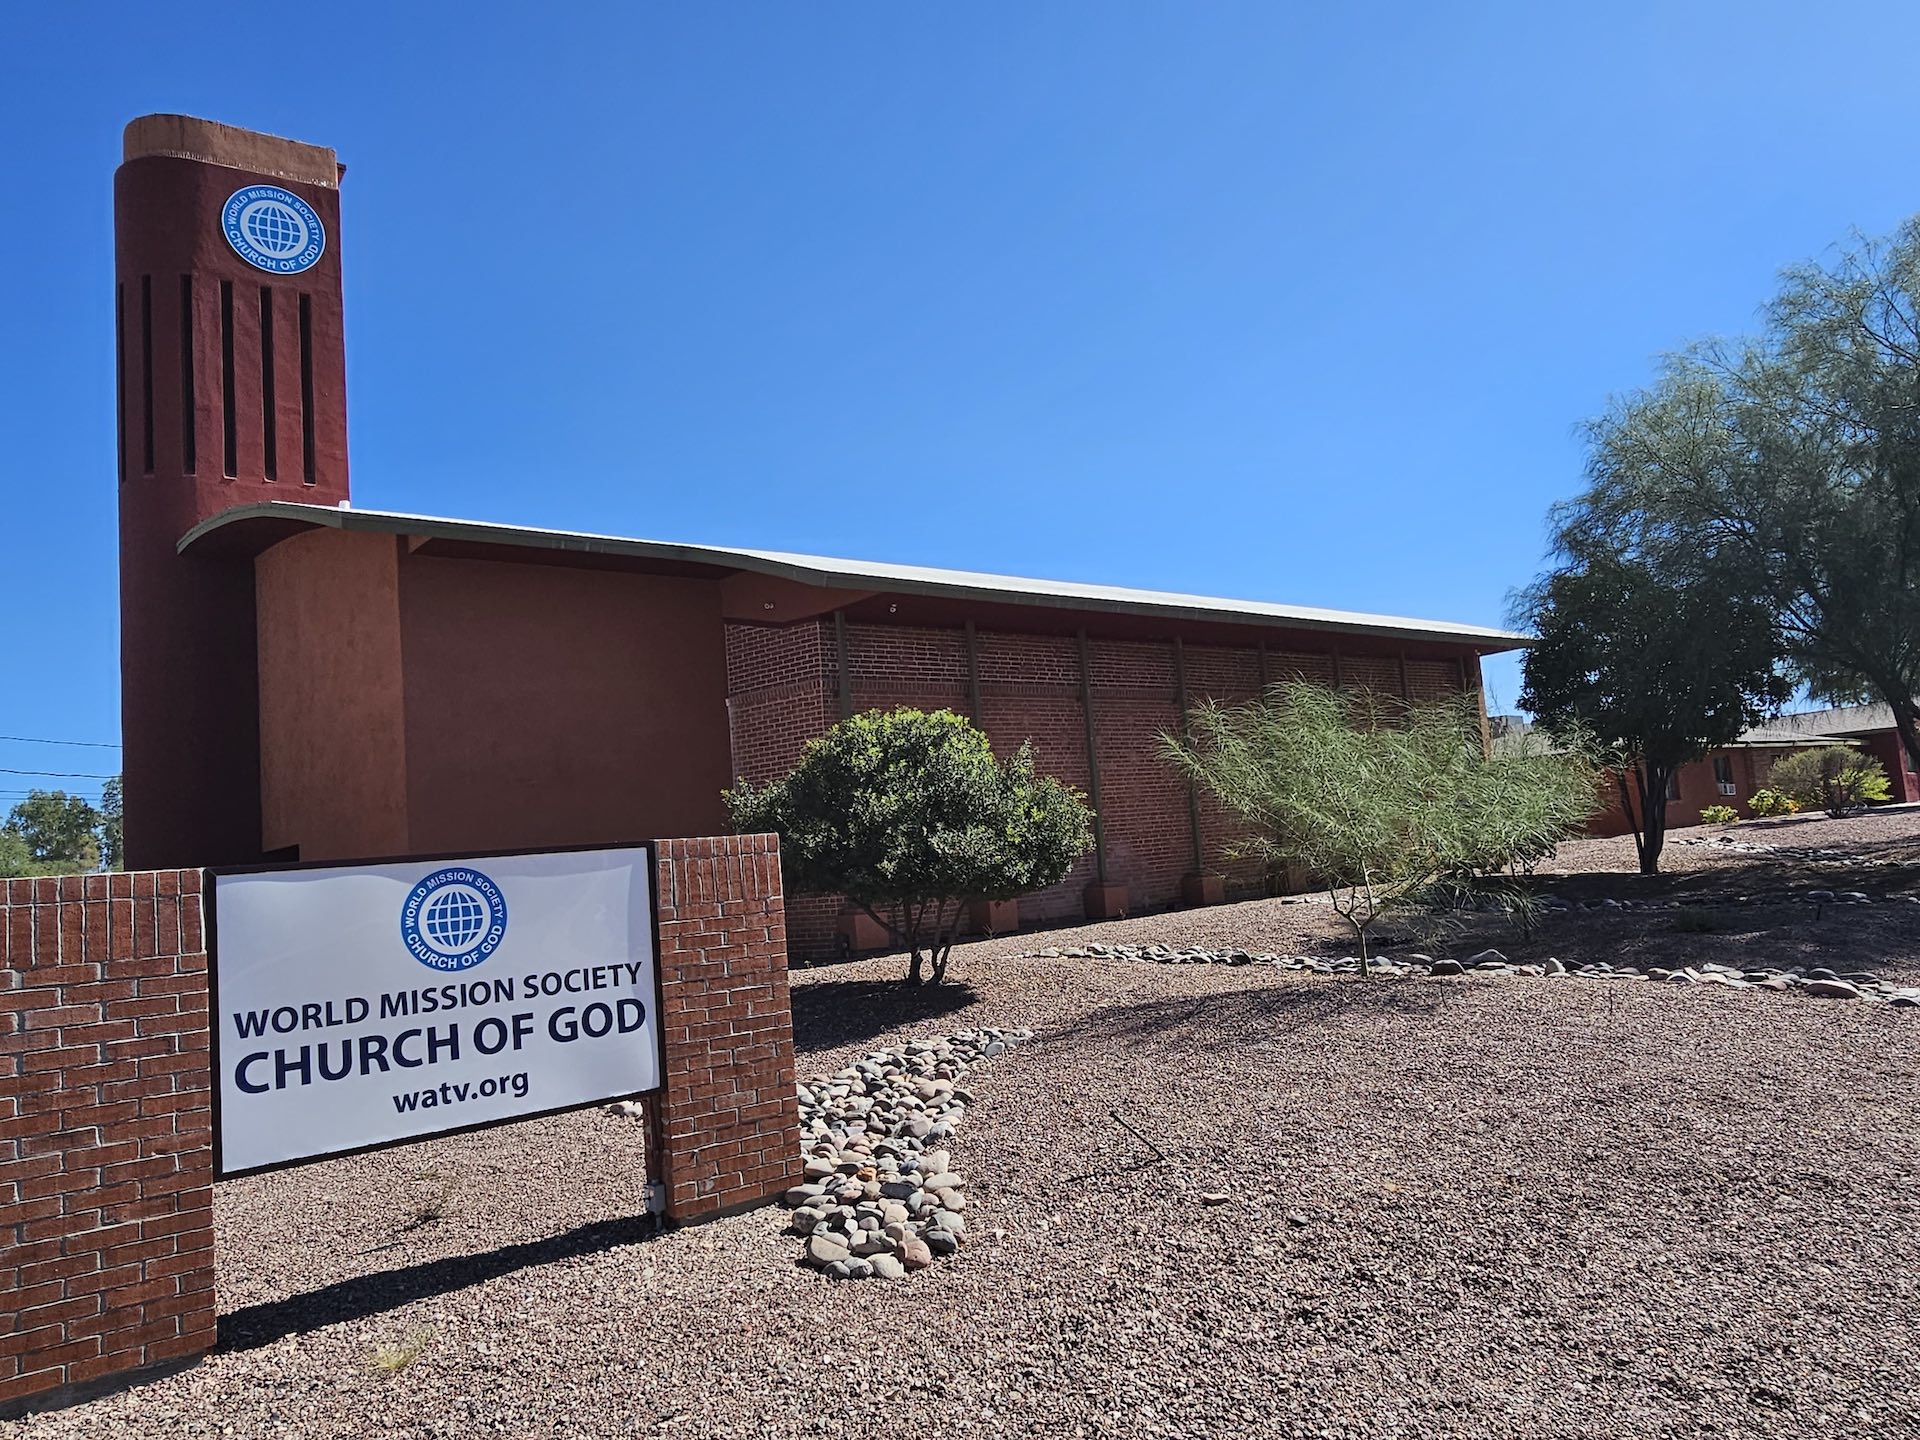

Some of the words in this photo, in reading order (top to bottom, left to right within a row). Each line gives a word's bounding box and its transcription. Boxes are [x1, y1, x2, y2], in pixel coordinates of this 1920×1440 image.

[228, 195, 248, 225] WORLD
[248, 190, 292, 204] MISSION
[294, 202, 320, 241] SOCIETY
[230, 230, 276, 269] CHURCH
[280, 259, 296, 270] OF
[299, 245, 319, 265] GOD
[405, 887, 427, 928] WORLD
[426, 872, 474, 889] MISSION
[475, 878, 504, 918] SOCIETY
[407, 934, 458, 969] CHURCH
[462, 951, 479, 966] OF
[481, 925, 502, 953] GOD
[233, 997, 369, 1039] WORLD
[380, 978, 515, 1019] MISSION
[524, 961, 642, 999] SOCIETY
[234, 1023, 460, 1094] CHURCH
[473, 1012, 535, 1055] OF
[548, 998, 646, 1043] GOD
[393, 1072, 529, 1114] watv.org
